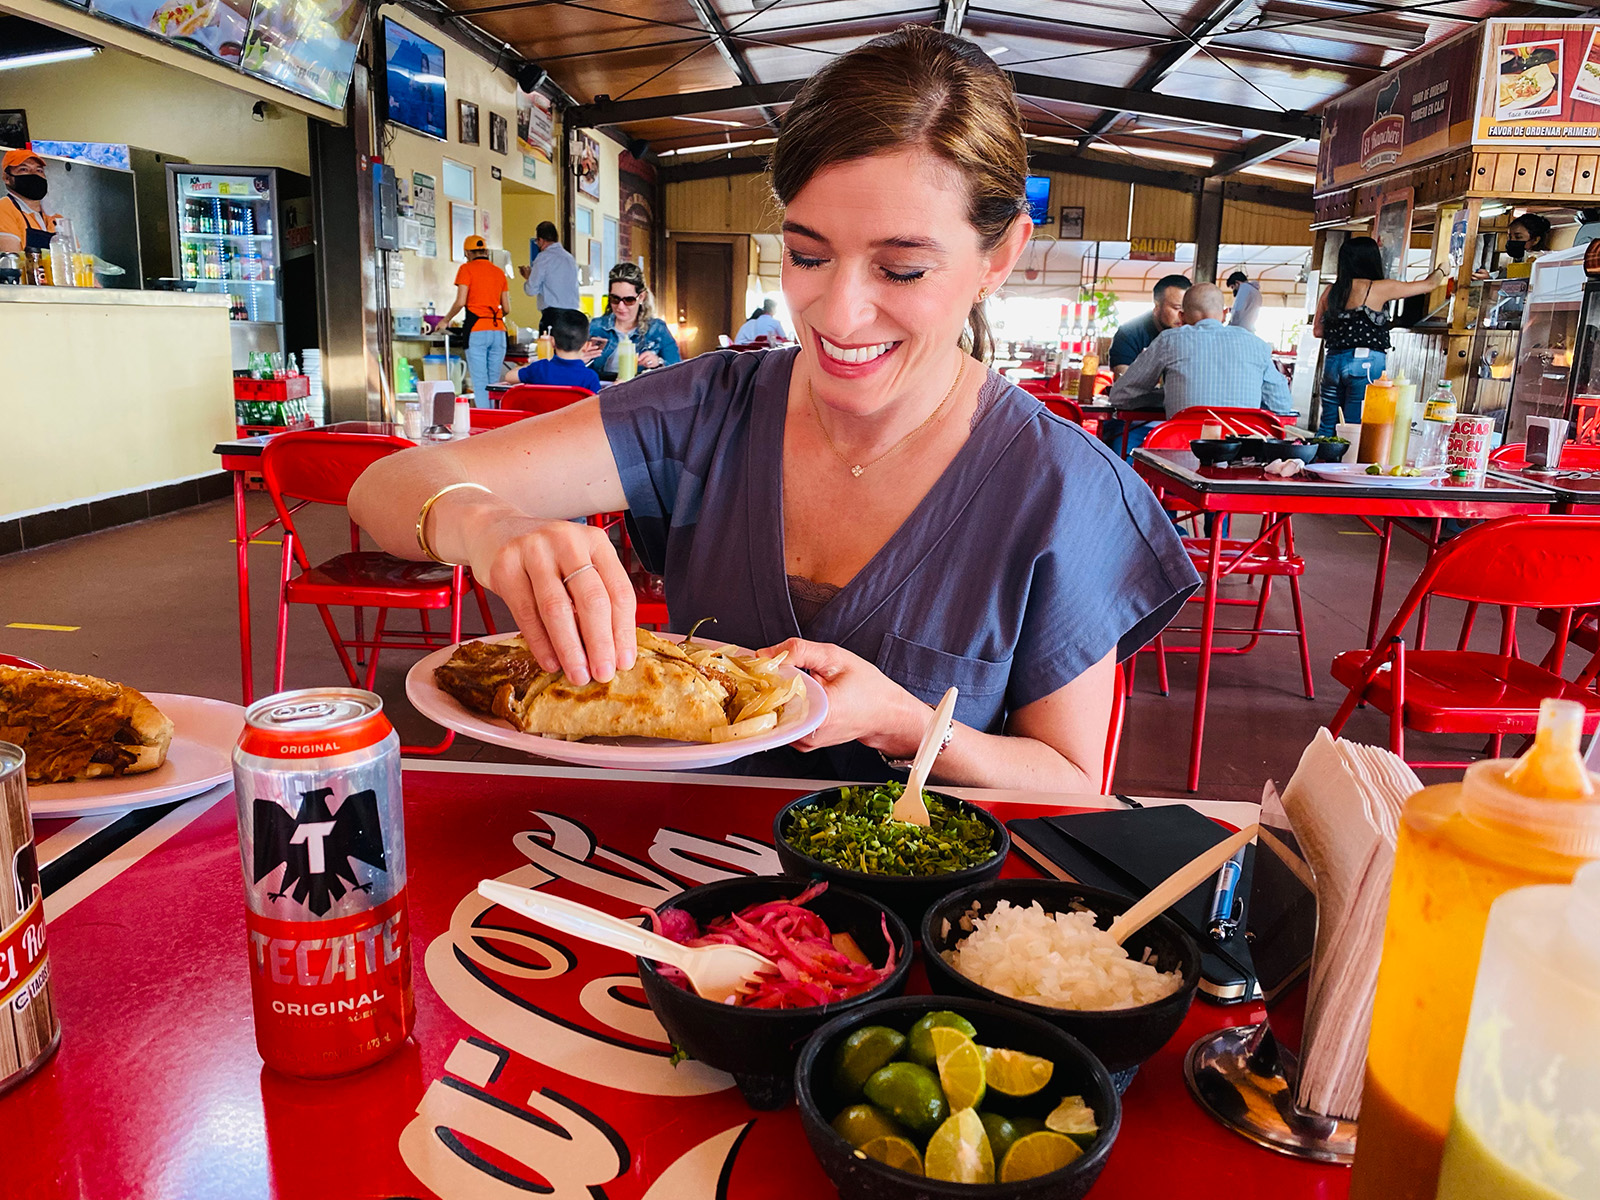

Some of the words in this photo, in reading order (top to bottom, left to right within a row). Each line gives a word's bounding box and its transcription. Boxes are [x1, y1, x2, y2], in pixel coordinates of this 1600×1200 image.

[1412, 91, 1424, 106] FAVOR
[1429, 80, 1449, 98] ORDENAR
[1411, 106, 1428, 122] PRIMERO
[1434, 98, 1445, 114] CAJA
[1364, 137, 1370, 156] El
[1371, 126, 1400, 150] Ranchero
[1488, 126, 1513, 137] FAVOR
[1514, 126, 1525, 137] DE
[1525, 126, 1561, 137] ORDENAR
[1562, 126, 1598, 137] PRIMERO
[1131, 238, 1176, 253] SALIDA
[1451, 421, 1489, 436] ACIAS
[1447, 437, 1463, 452] OR
[1466, 439, 1483, 453] SU
[280, 742, 341, 755] ORIGINAL
[289, 820, 338, 874] T
[250, 909, 403, 986] TECATE
[272, 989, 385, 1017] ORIGINAL
